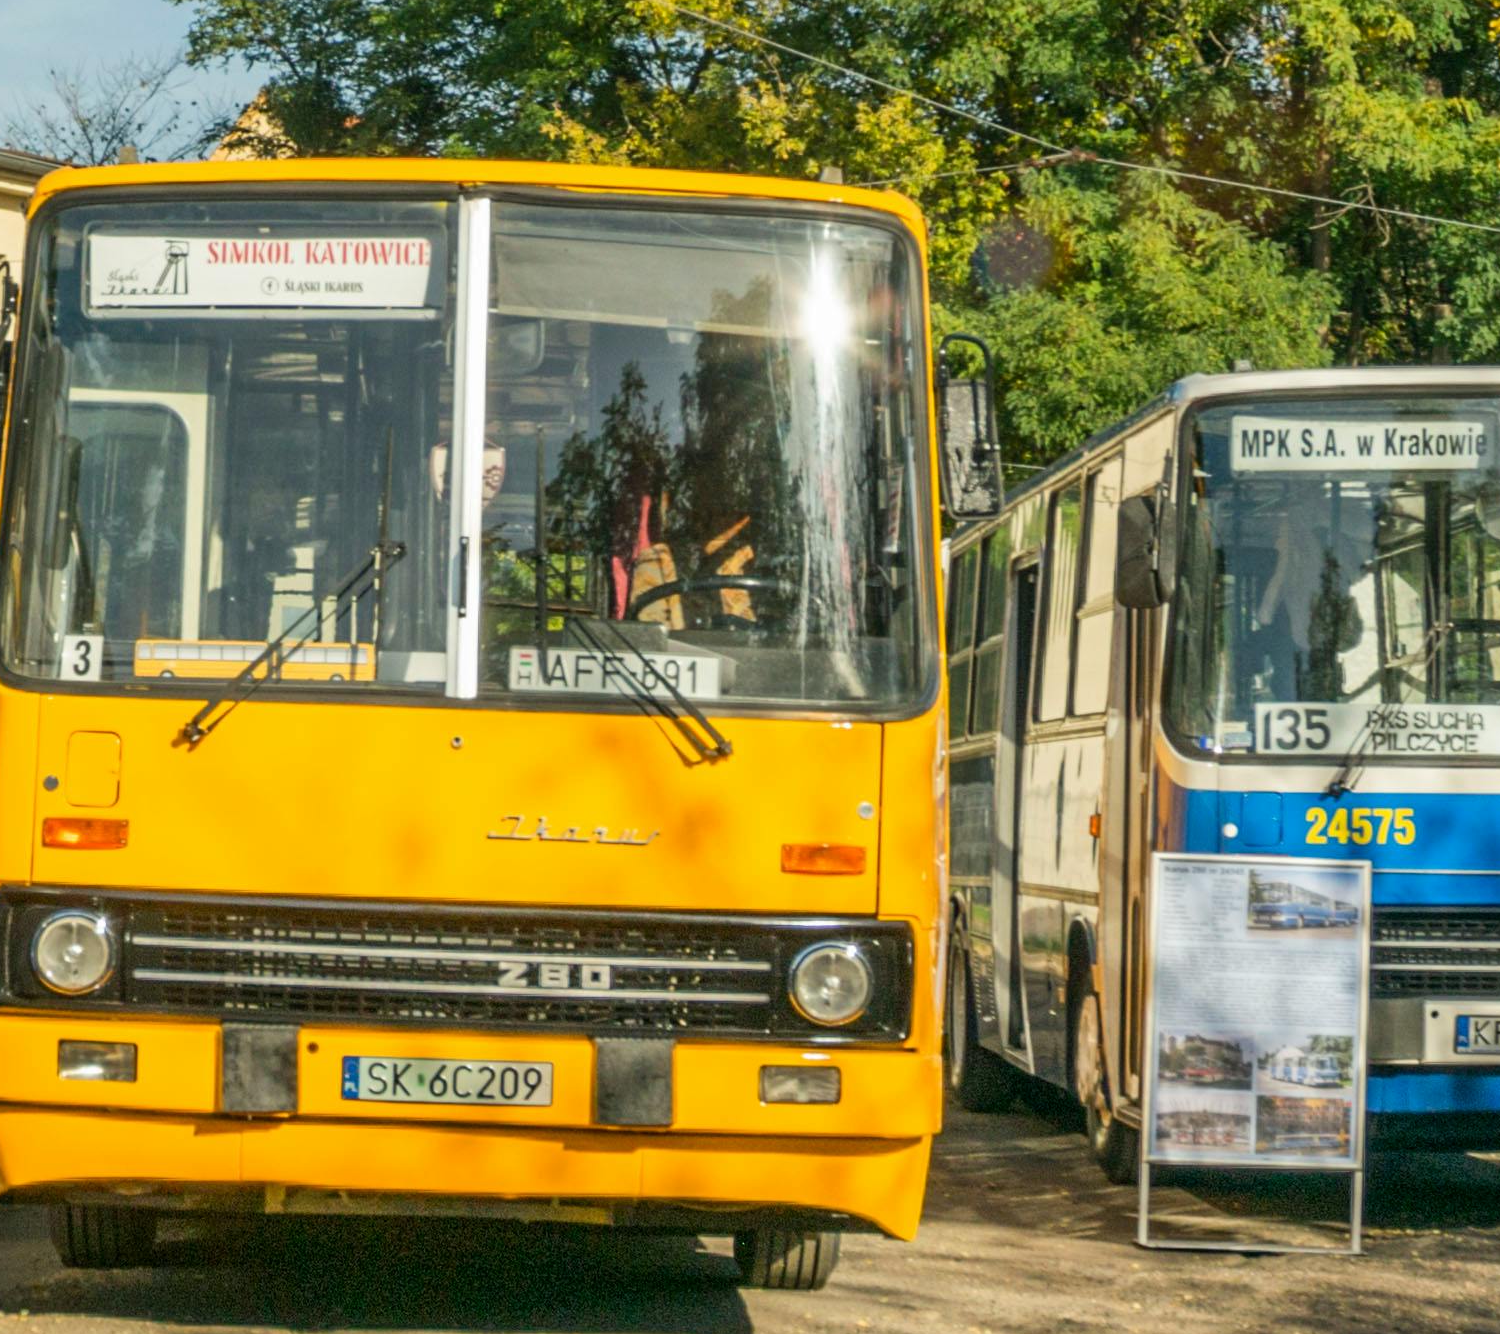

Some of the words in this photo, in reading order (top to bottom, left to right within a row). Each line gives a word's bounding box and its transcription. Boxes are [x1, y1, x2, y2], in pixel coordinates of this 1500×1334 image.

[206, 240, 295, 266] SIMKOL
[305, 240, 430, 267] KATOWICE
[284, 278, 321, 294] ŚLĄSKI
[324, 281, 364, 293] IKARUS
[1240, 428, 1291, 458] MPK
[1300, 428, 1346, 458] S.A.
[1356, 434, 1375, 456] w
[1383, 427, 1488, 456] Krakowie
[72, 640, 91, 676] 3
[546, 654, 698, 694] AFF-691
[1261, 708, 1332, 751] 135
[1365, 710, 1408, 729] PKS
[1413, 710, 1485, 731] SUCHA
[1371, 733, 1479, 753] PILCZYCE
[486, 814, 661, 846] Ikarus
[1305, 806, 1417, 846] 24575
[498, 961, 611, 988] 280
[367, 1061, 412, 1097] SK
[428, 1064, 543, 1101] 6C209
